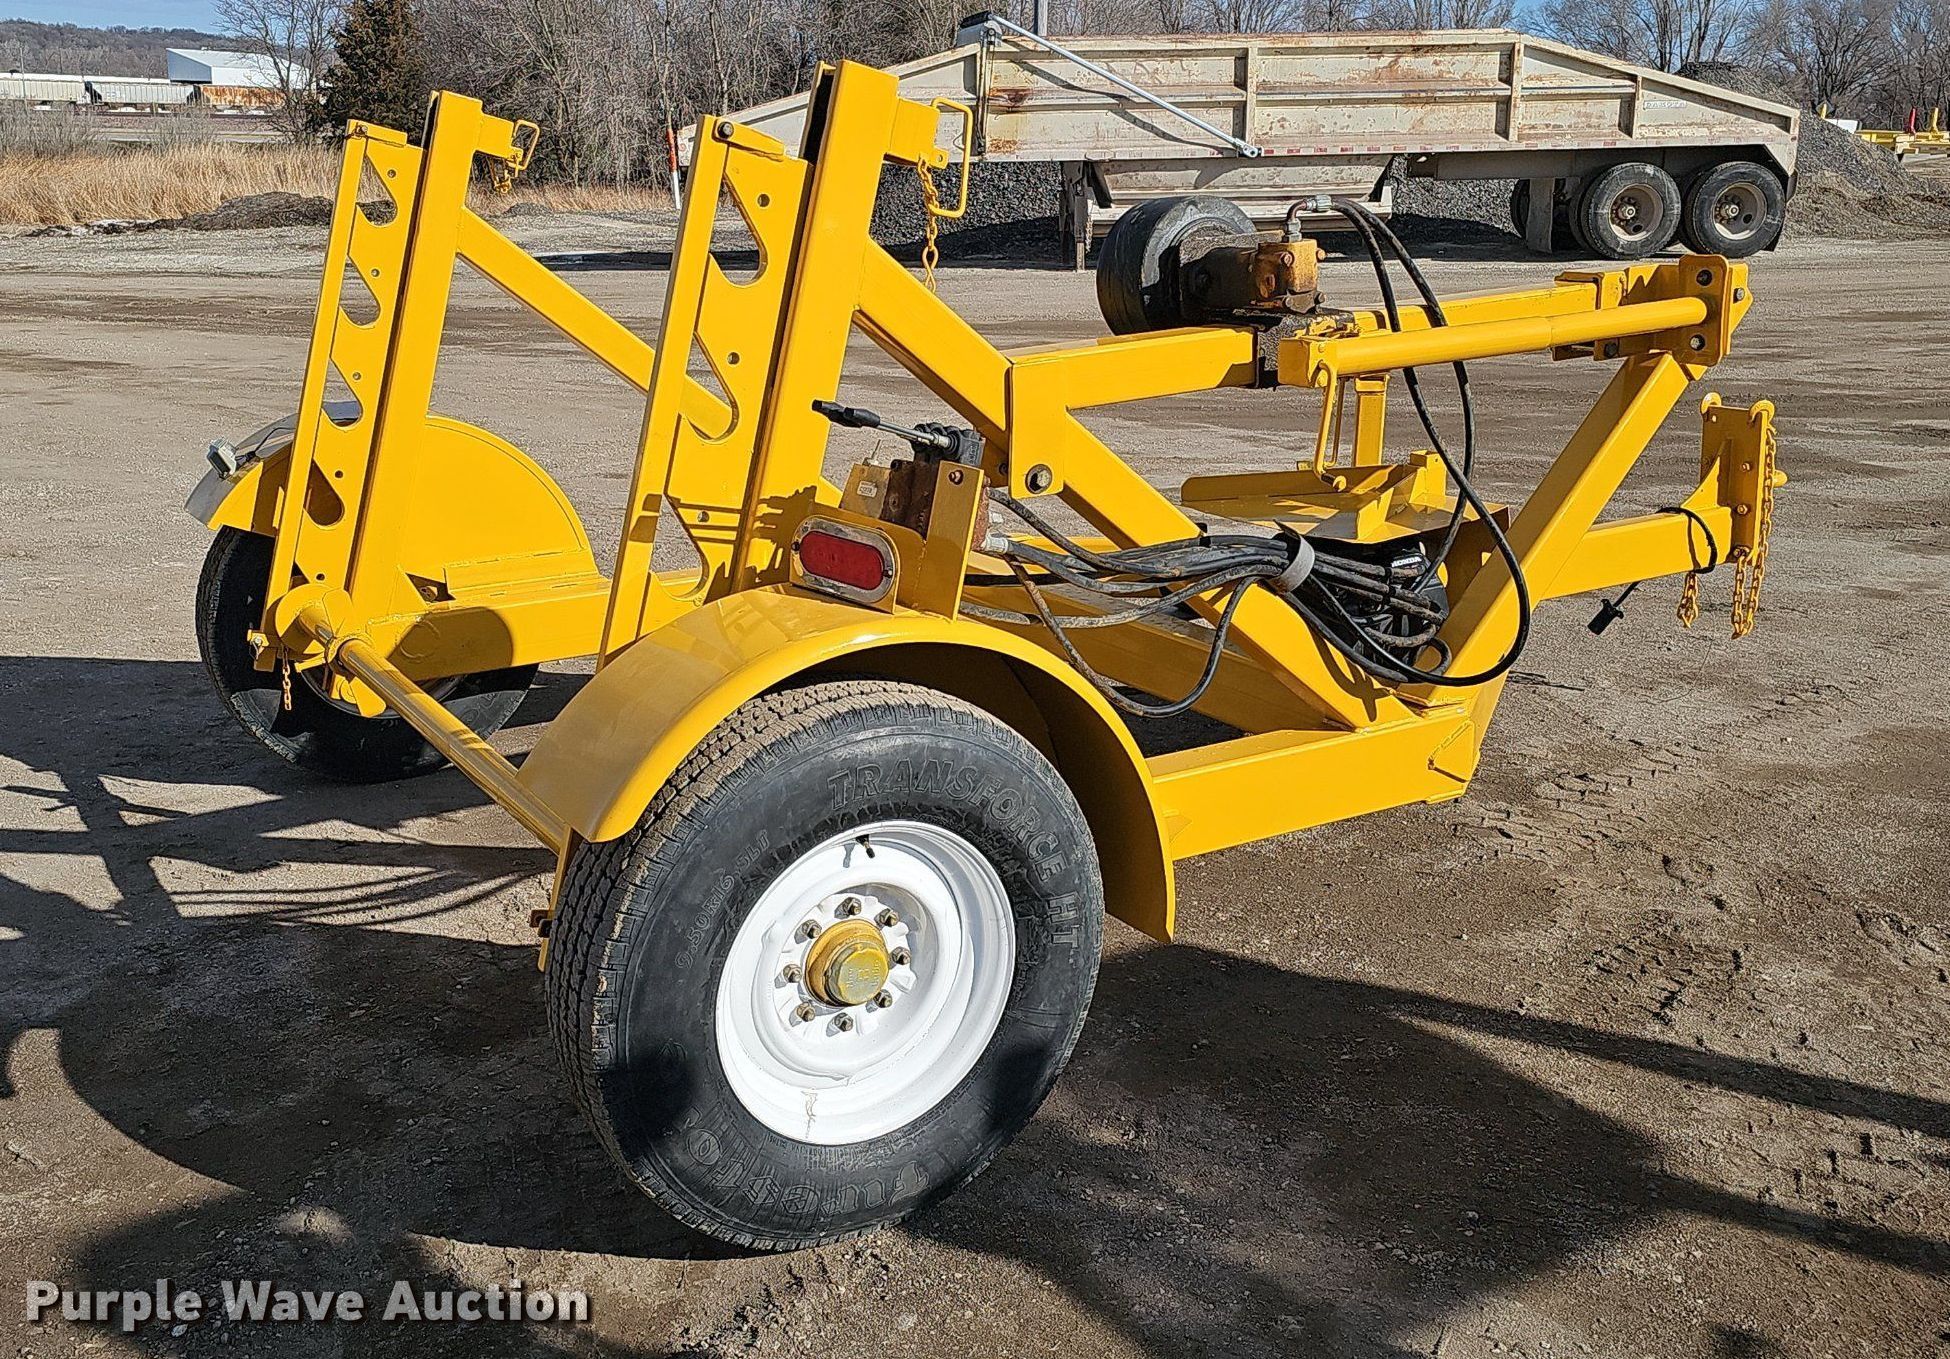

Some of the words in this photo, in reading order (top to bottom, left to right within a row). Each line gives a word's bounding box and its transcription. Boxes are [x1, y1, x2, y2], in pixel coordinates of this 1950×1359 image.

[1391, 556, 1422, 568] HONDA
[827, 758, 1068, 882] TRANSFORCE
[1049, 892, 1083, 949] HT
